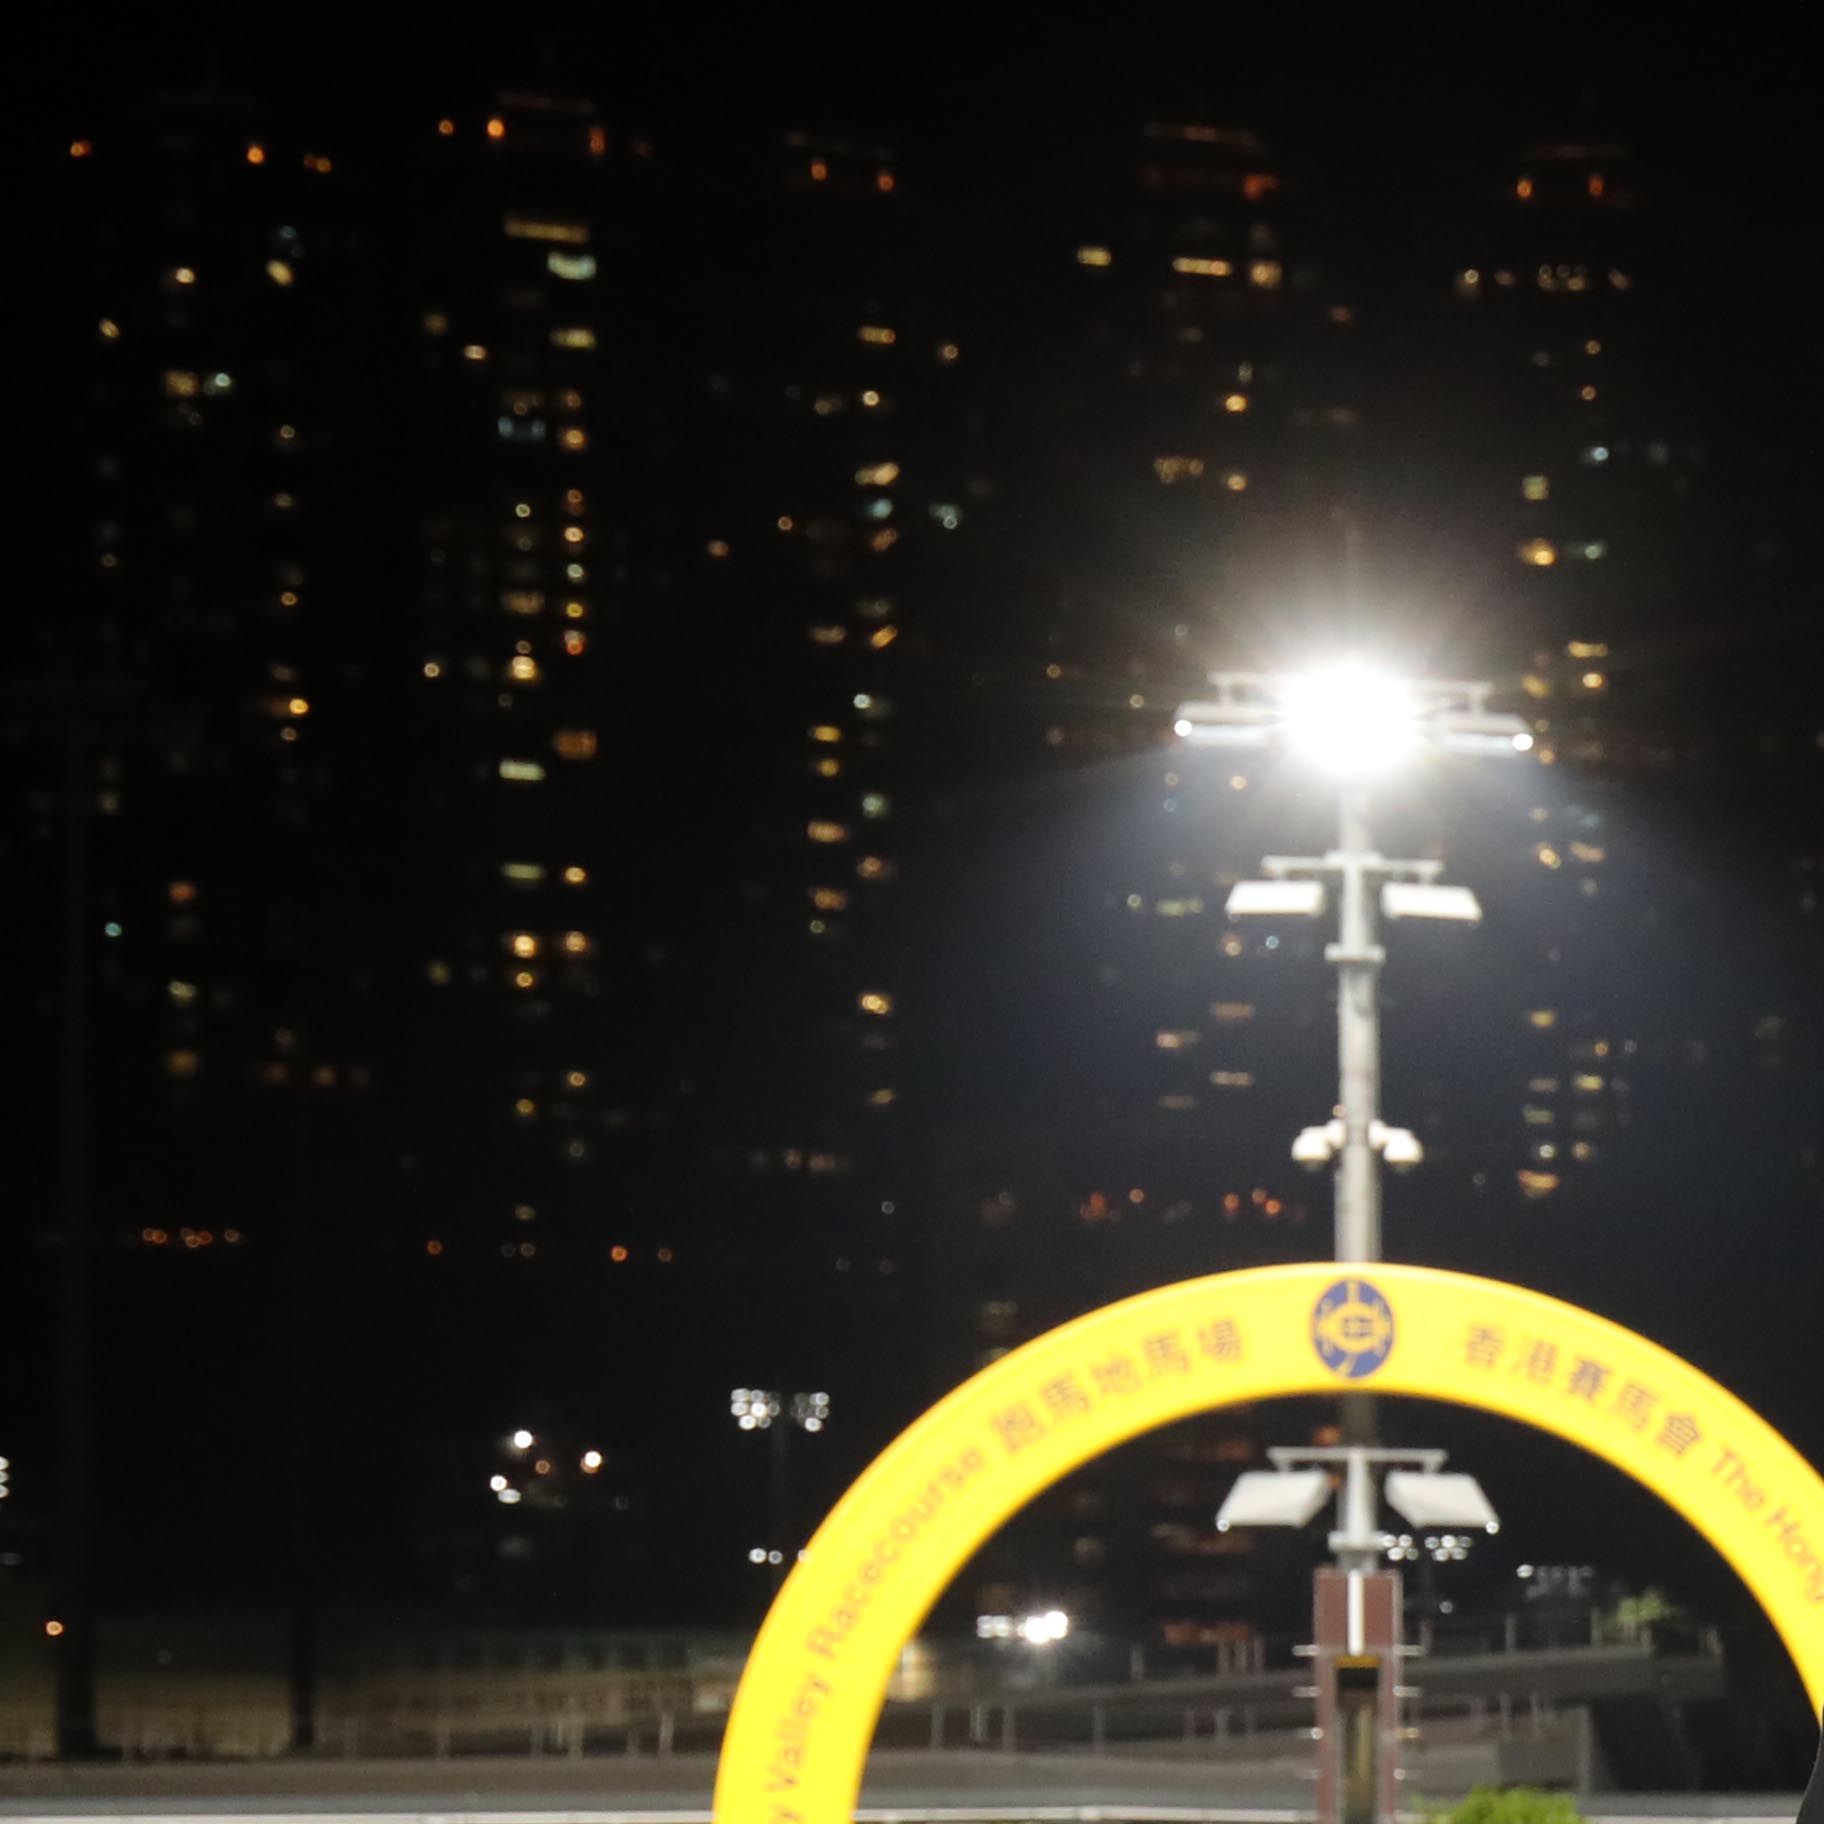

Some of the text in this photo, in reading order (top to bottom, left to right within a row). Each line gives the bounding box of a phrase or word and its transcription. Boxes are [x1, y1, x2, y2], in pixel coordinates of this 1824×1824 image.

[765, 1672, 830, 1796] Valley
[806, 1444, 988, 1660] Racecourse
[991, 1317, 1245, 1452] 跑馬地馬場
[1465, 1325, 1702, 1457] 香港賽馬會
[1711, 1443, 1767, 1513] The
